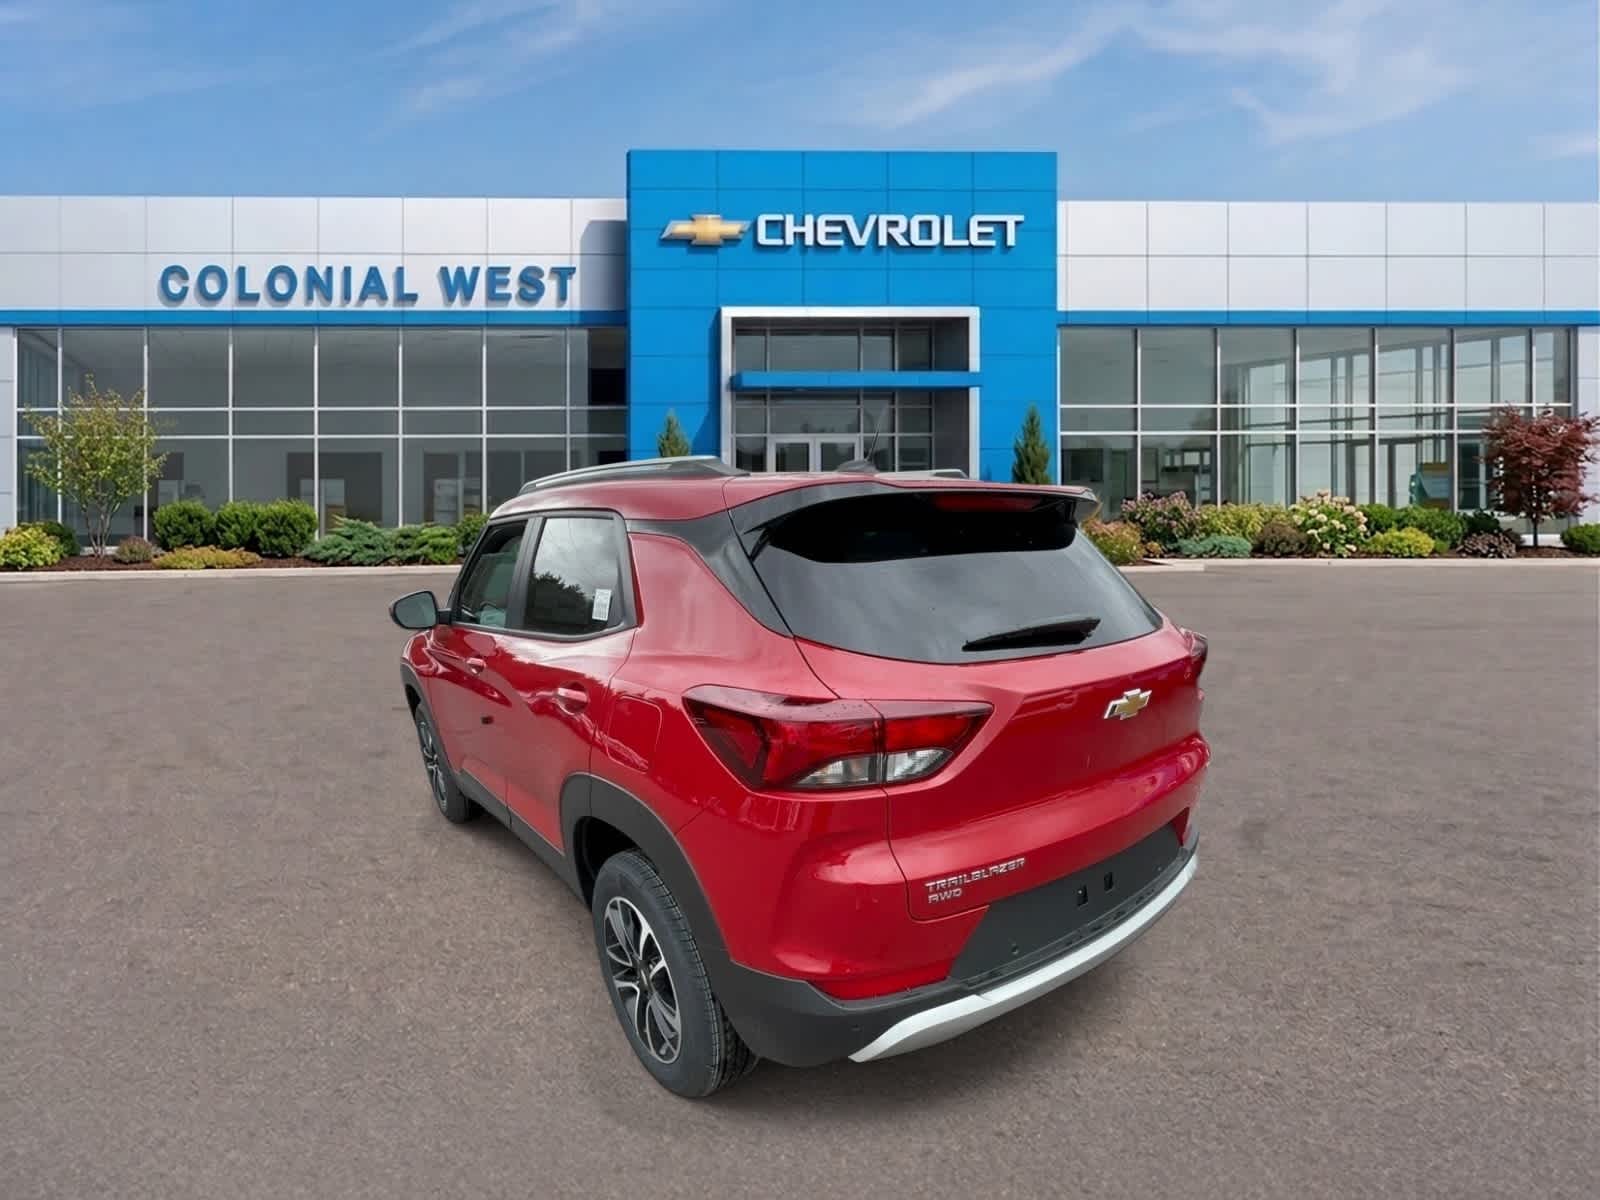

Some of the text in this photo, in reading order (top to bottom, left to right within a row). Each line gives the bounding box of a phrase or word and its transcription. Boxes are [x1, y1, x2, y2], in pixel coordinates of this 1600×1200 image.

[756, 213, 1024, 247] CHEVROLET
[159, 264, 577, 306] COLONIAL WEST
[925, 857, 1025, 892] TRAILBLAZER
[928, 888, 963, 904] AWD
